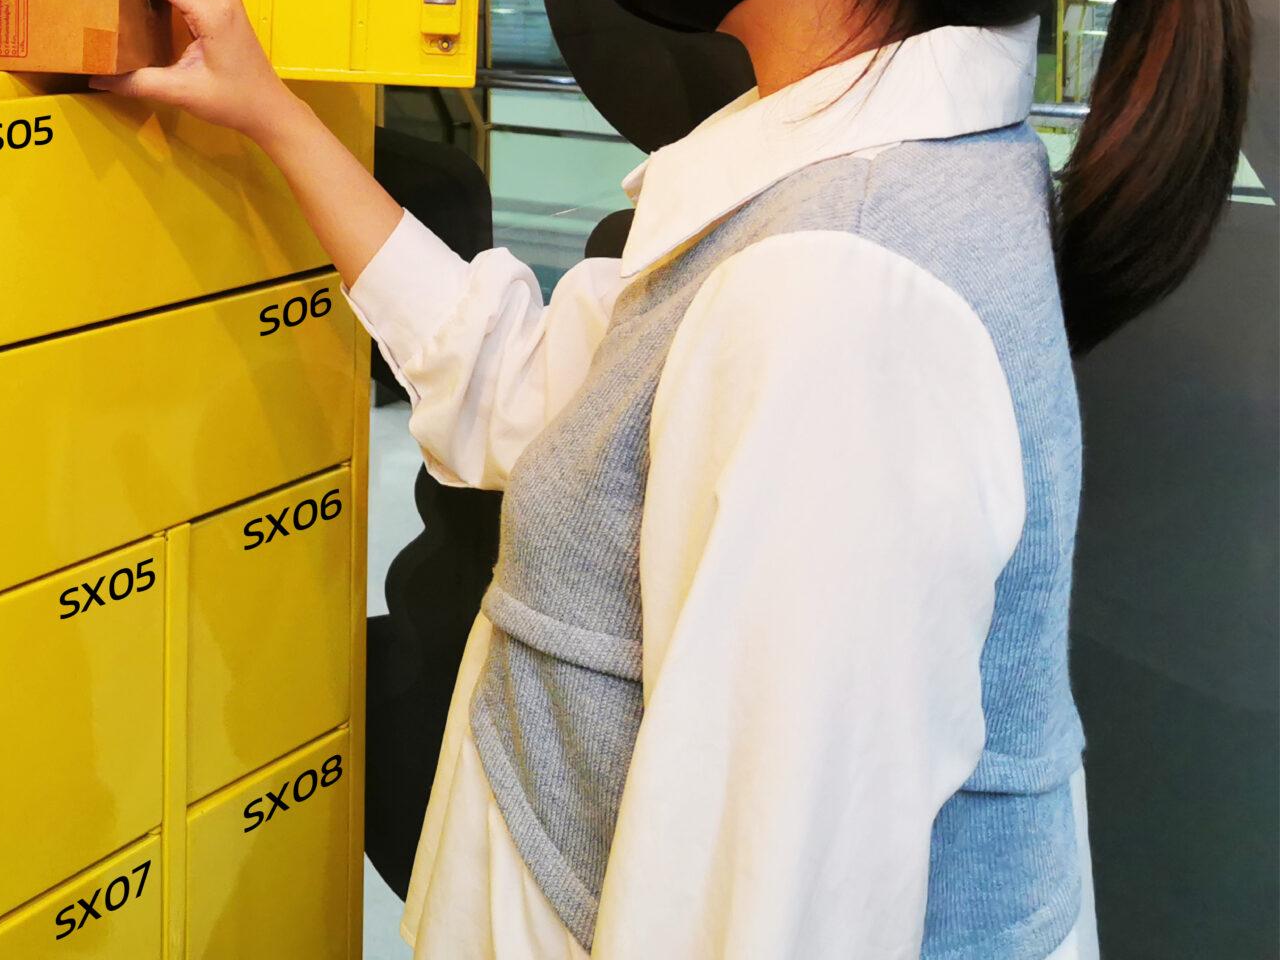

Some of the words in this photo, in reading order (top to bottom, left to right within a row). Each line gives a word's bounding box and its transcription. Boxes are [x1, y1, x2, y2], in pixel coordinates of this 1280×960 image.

[259, 287, 333, 337] S06
[243, 488, 343, 551] SX06
[59, 557, 156, 620] SX05
[243, 753, 344, 834] SX08
[55, 859, 152, 941] SX07
